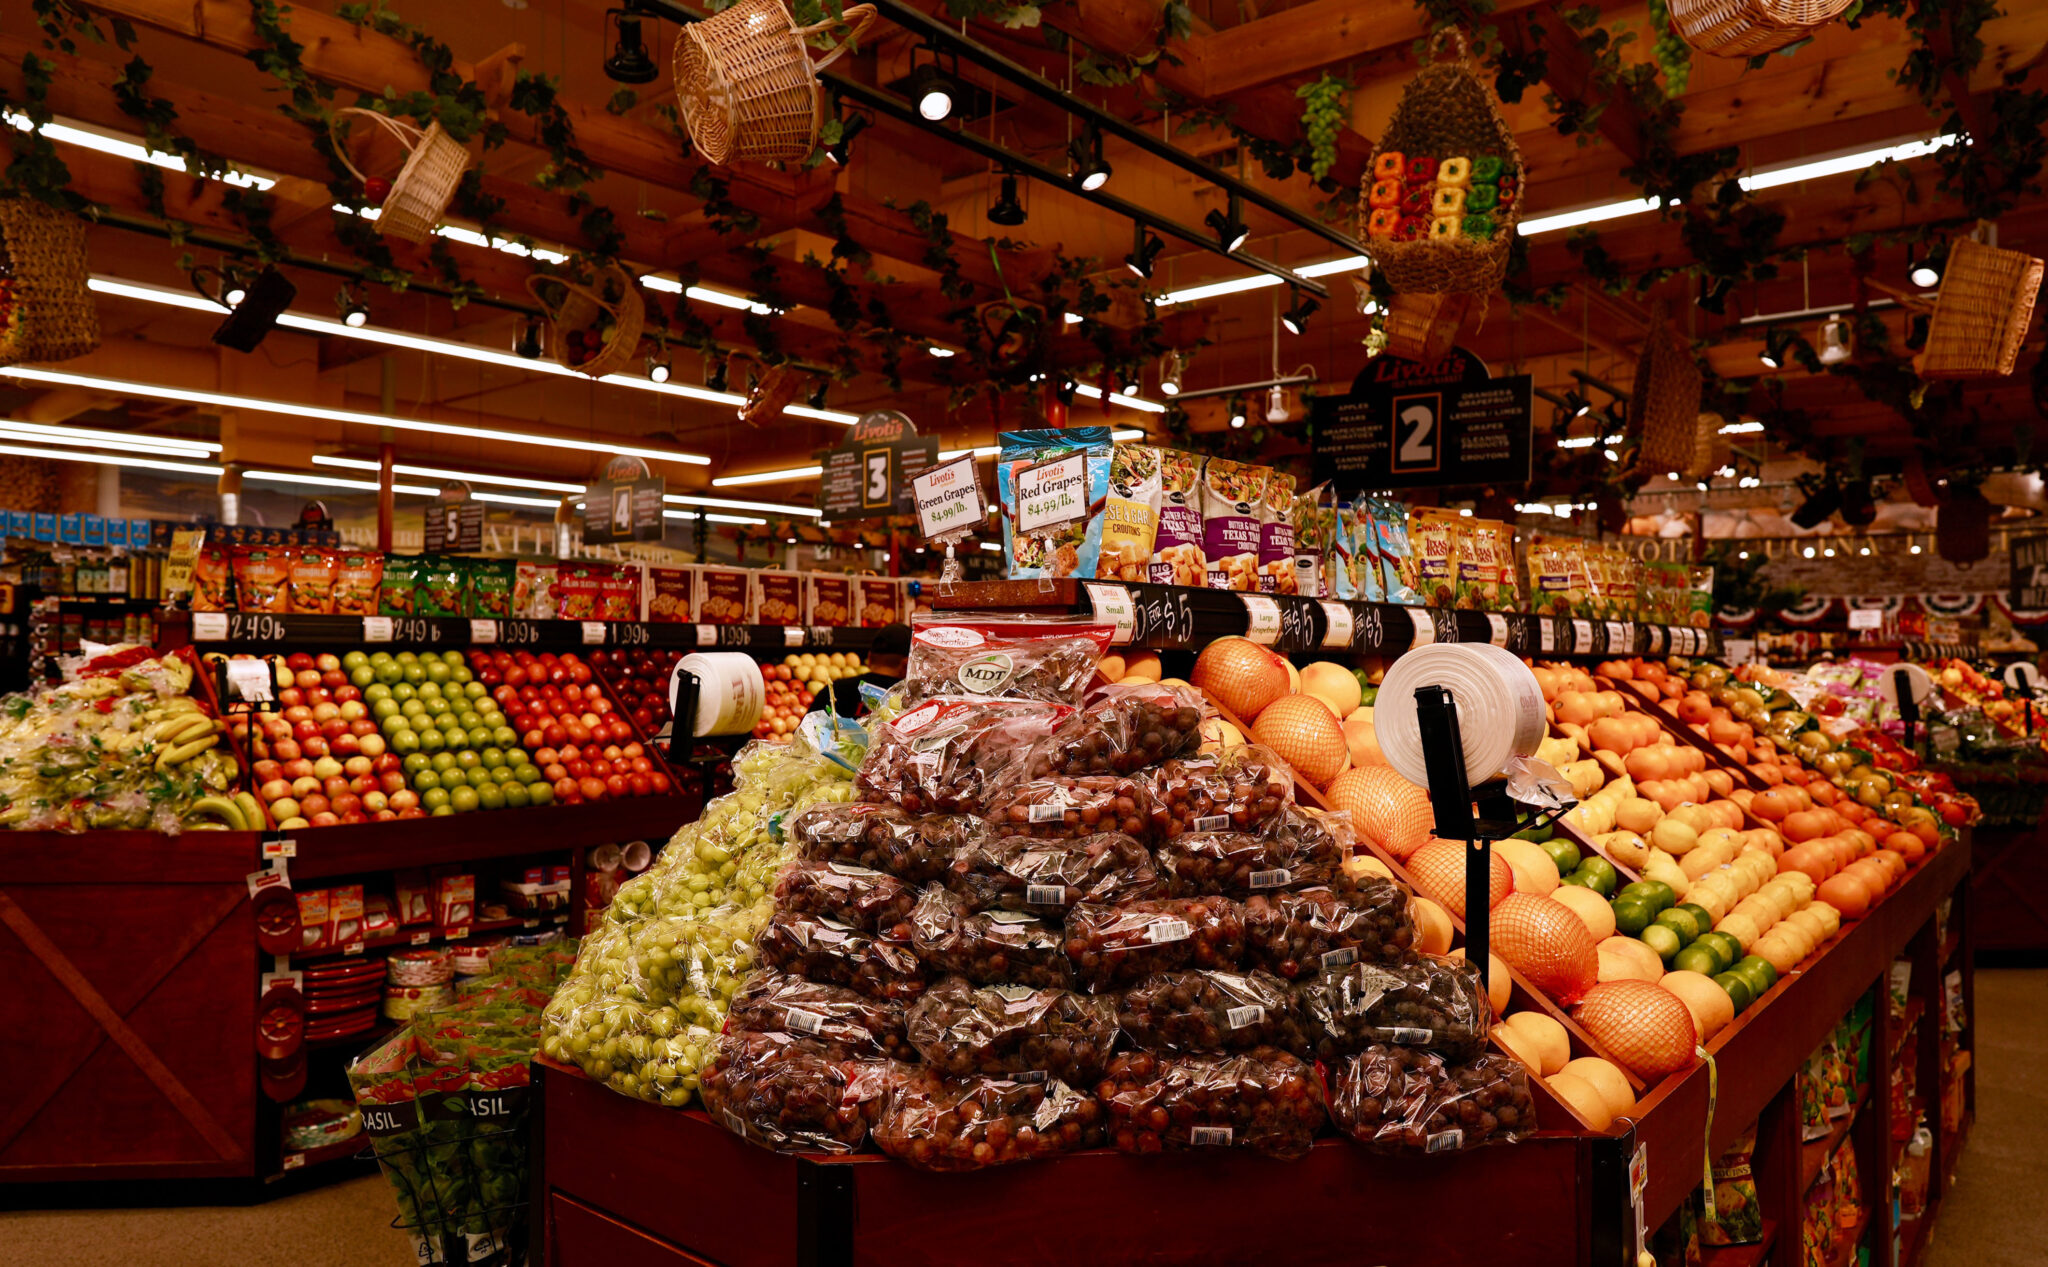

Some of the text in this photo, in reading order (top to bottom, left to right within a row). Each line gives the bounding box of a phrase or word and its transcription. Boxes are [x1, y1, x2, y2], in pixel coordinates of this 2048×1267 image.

[1400, 405, 1434, 462] 2
[868, 457, 887, 500] 3
[929, 468, 955, 487] Livoti's
[1036, 463, 1064, 481] Livoti's
[1020, 474, 1082, 500] Red Grapes
[919, 483, 975, 511] Green Grapes
[615, 493, 629, 528] 4
[447, 510, 458, 542] 5
[1113, 523, 1141, 536] CROUTONS
[1223, 530, 1248, 541] TEXAS
[1151, 564, 1170, 573] BIG
[1208, 572, 1226, 582] BIG
[1106, 606, 1125, 615] Small
[1260, 613, 1273, 622] Large
[965, 668, 1006, 681] MDT
[470, 1097, 510, 1117] ASIL
